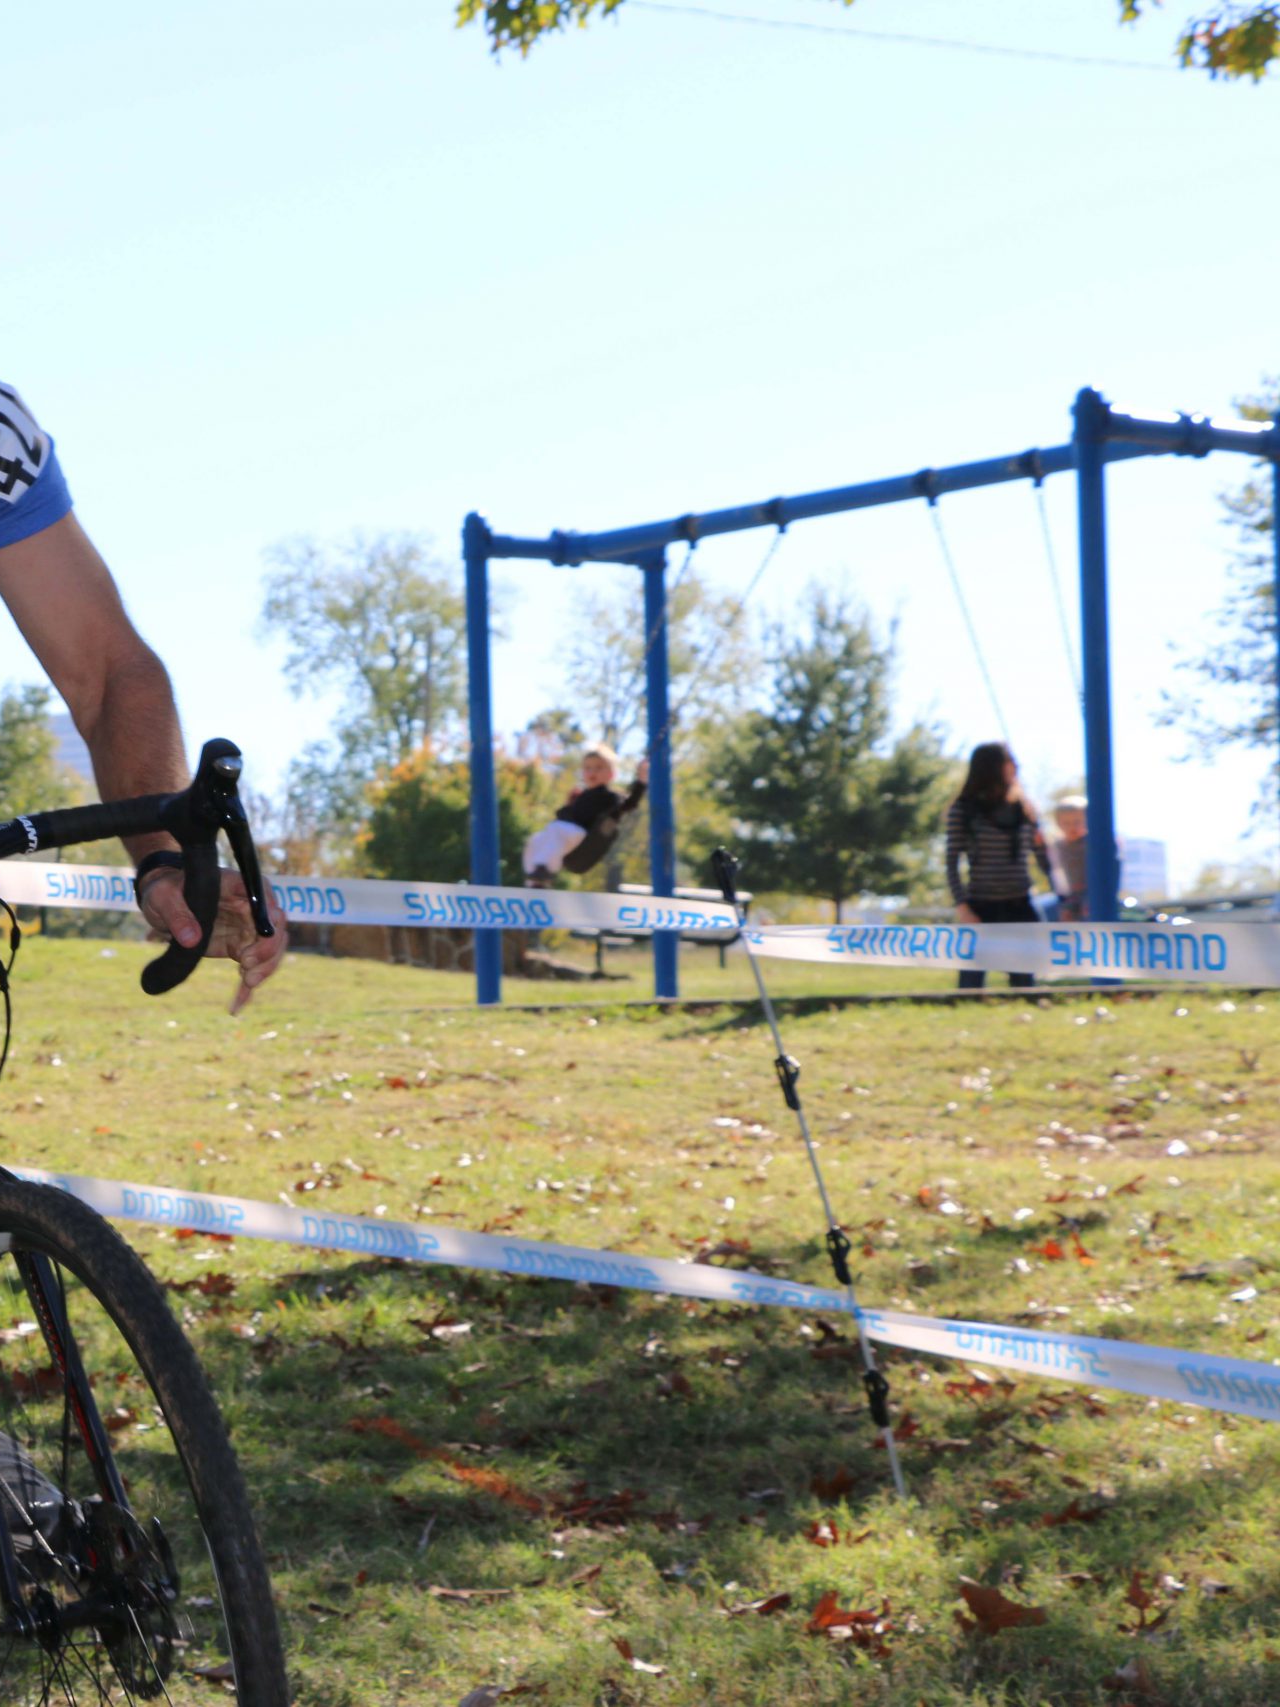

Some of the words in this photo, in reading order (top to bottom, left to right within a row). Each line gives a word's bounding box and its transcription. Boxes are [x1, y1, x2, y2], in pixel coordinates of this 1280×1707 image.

[47, 872, 136, 902] SHIMA
[404, 891, 554, 926] SHIMANO
[826, 926, 978, 960] SHIMANO
[1050, 930, 1227, 971] SHIMANO
